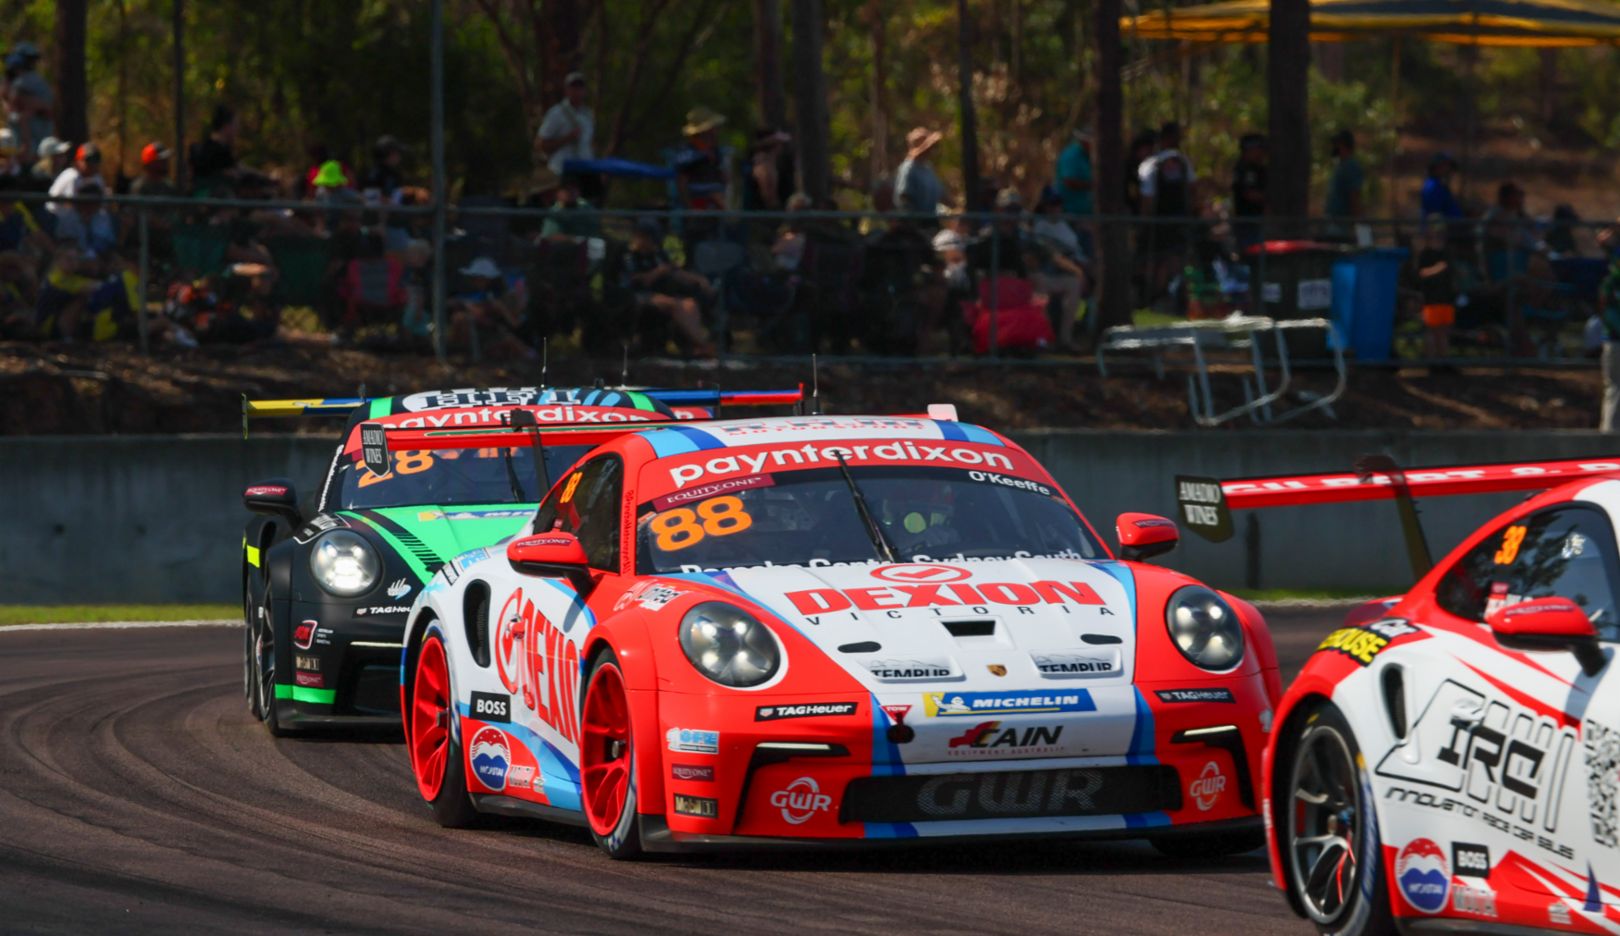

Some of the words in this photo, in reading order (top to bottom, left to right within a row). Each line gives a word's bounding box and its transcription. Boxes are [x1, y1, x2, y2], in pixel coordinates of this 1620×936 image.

[669, 441, 1014, 488] paynterdixon
[968, 470, 1050, 495] O'Keeffe
[650, 495, 752, 551] 88
[1184, 504, 1218, 526] WINES
[784, 580, 1107, 616] DEXION
[803, 606, 1115, 626] VICTORIA
[521, 598, 582, 749] DEXIO
[476, 698, 506, 716] BOSS
[776, 704, 852, 716] TAGHeuer
[972, 695, 1079, 708] MICHELIN
[970, 725, 1064, 748] CAIN
[1437, 717, 1545, 800] IRC
[916, 770, 1103, 815] GWR
[1189, 775, 1226, 797] GWR
[770, 791, 832, 811] GWR
[1457, 850, 1487, 870] BOSS
